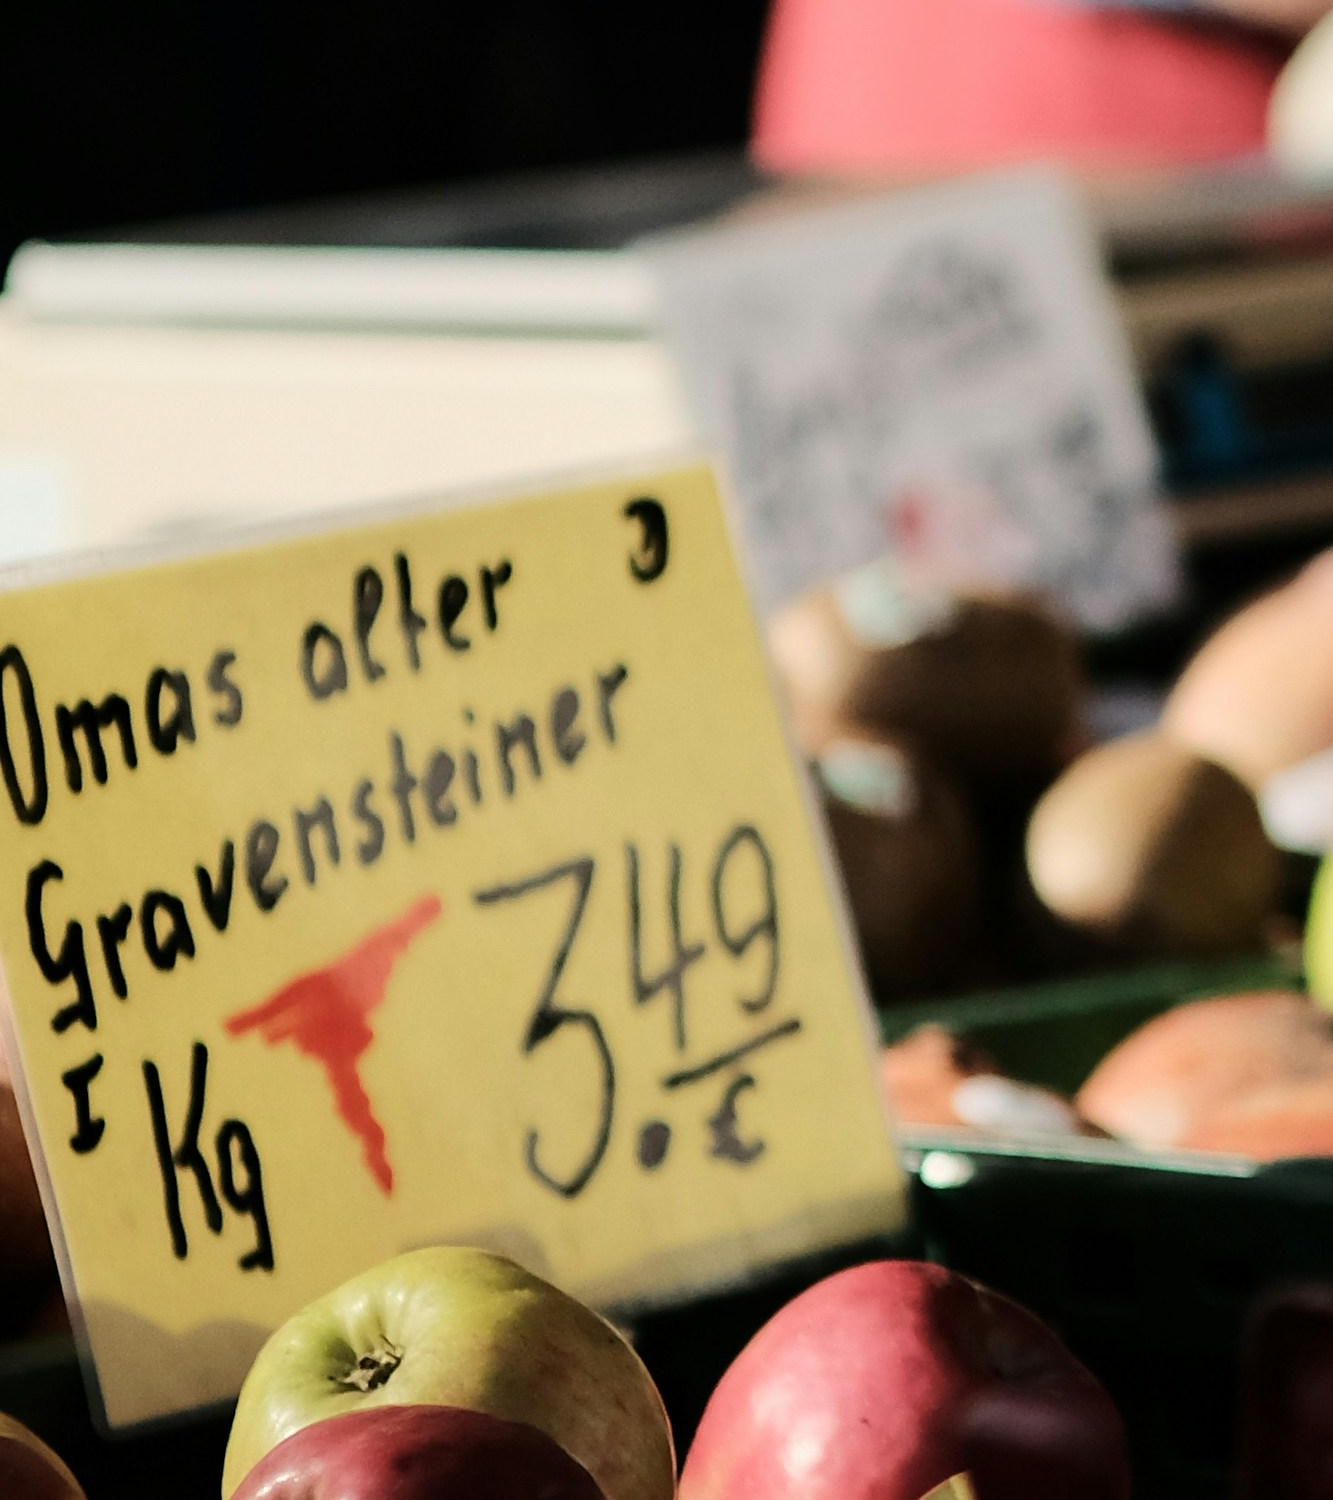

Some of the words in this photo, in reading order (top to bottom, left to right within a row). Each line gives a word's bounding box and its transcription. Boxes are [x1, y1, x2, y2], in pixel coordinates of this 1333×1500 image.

[0, 643, 243, 826] Omas
[301, 551, 513, 703] alter
[24, 661, 628, 1034] Gravensteiner
